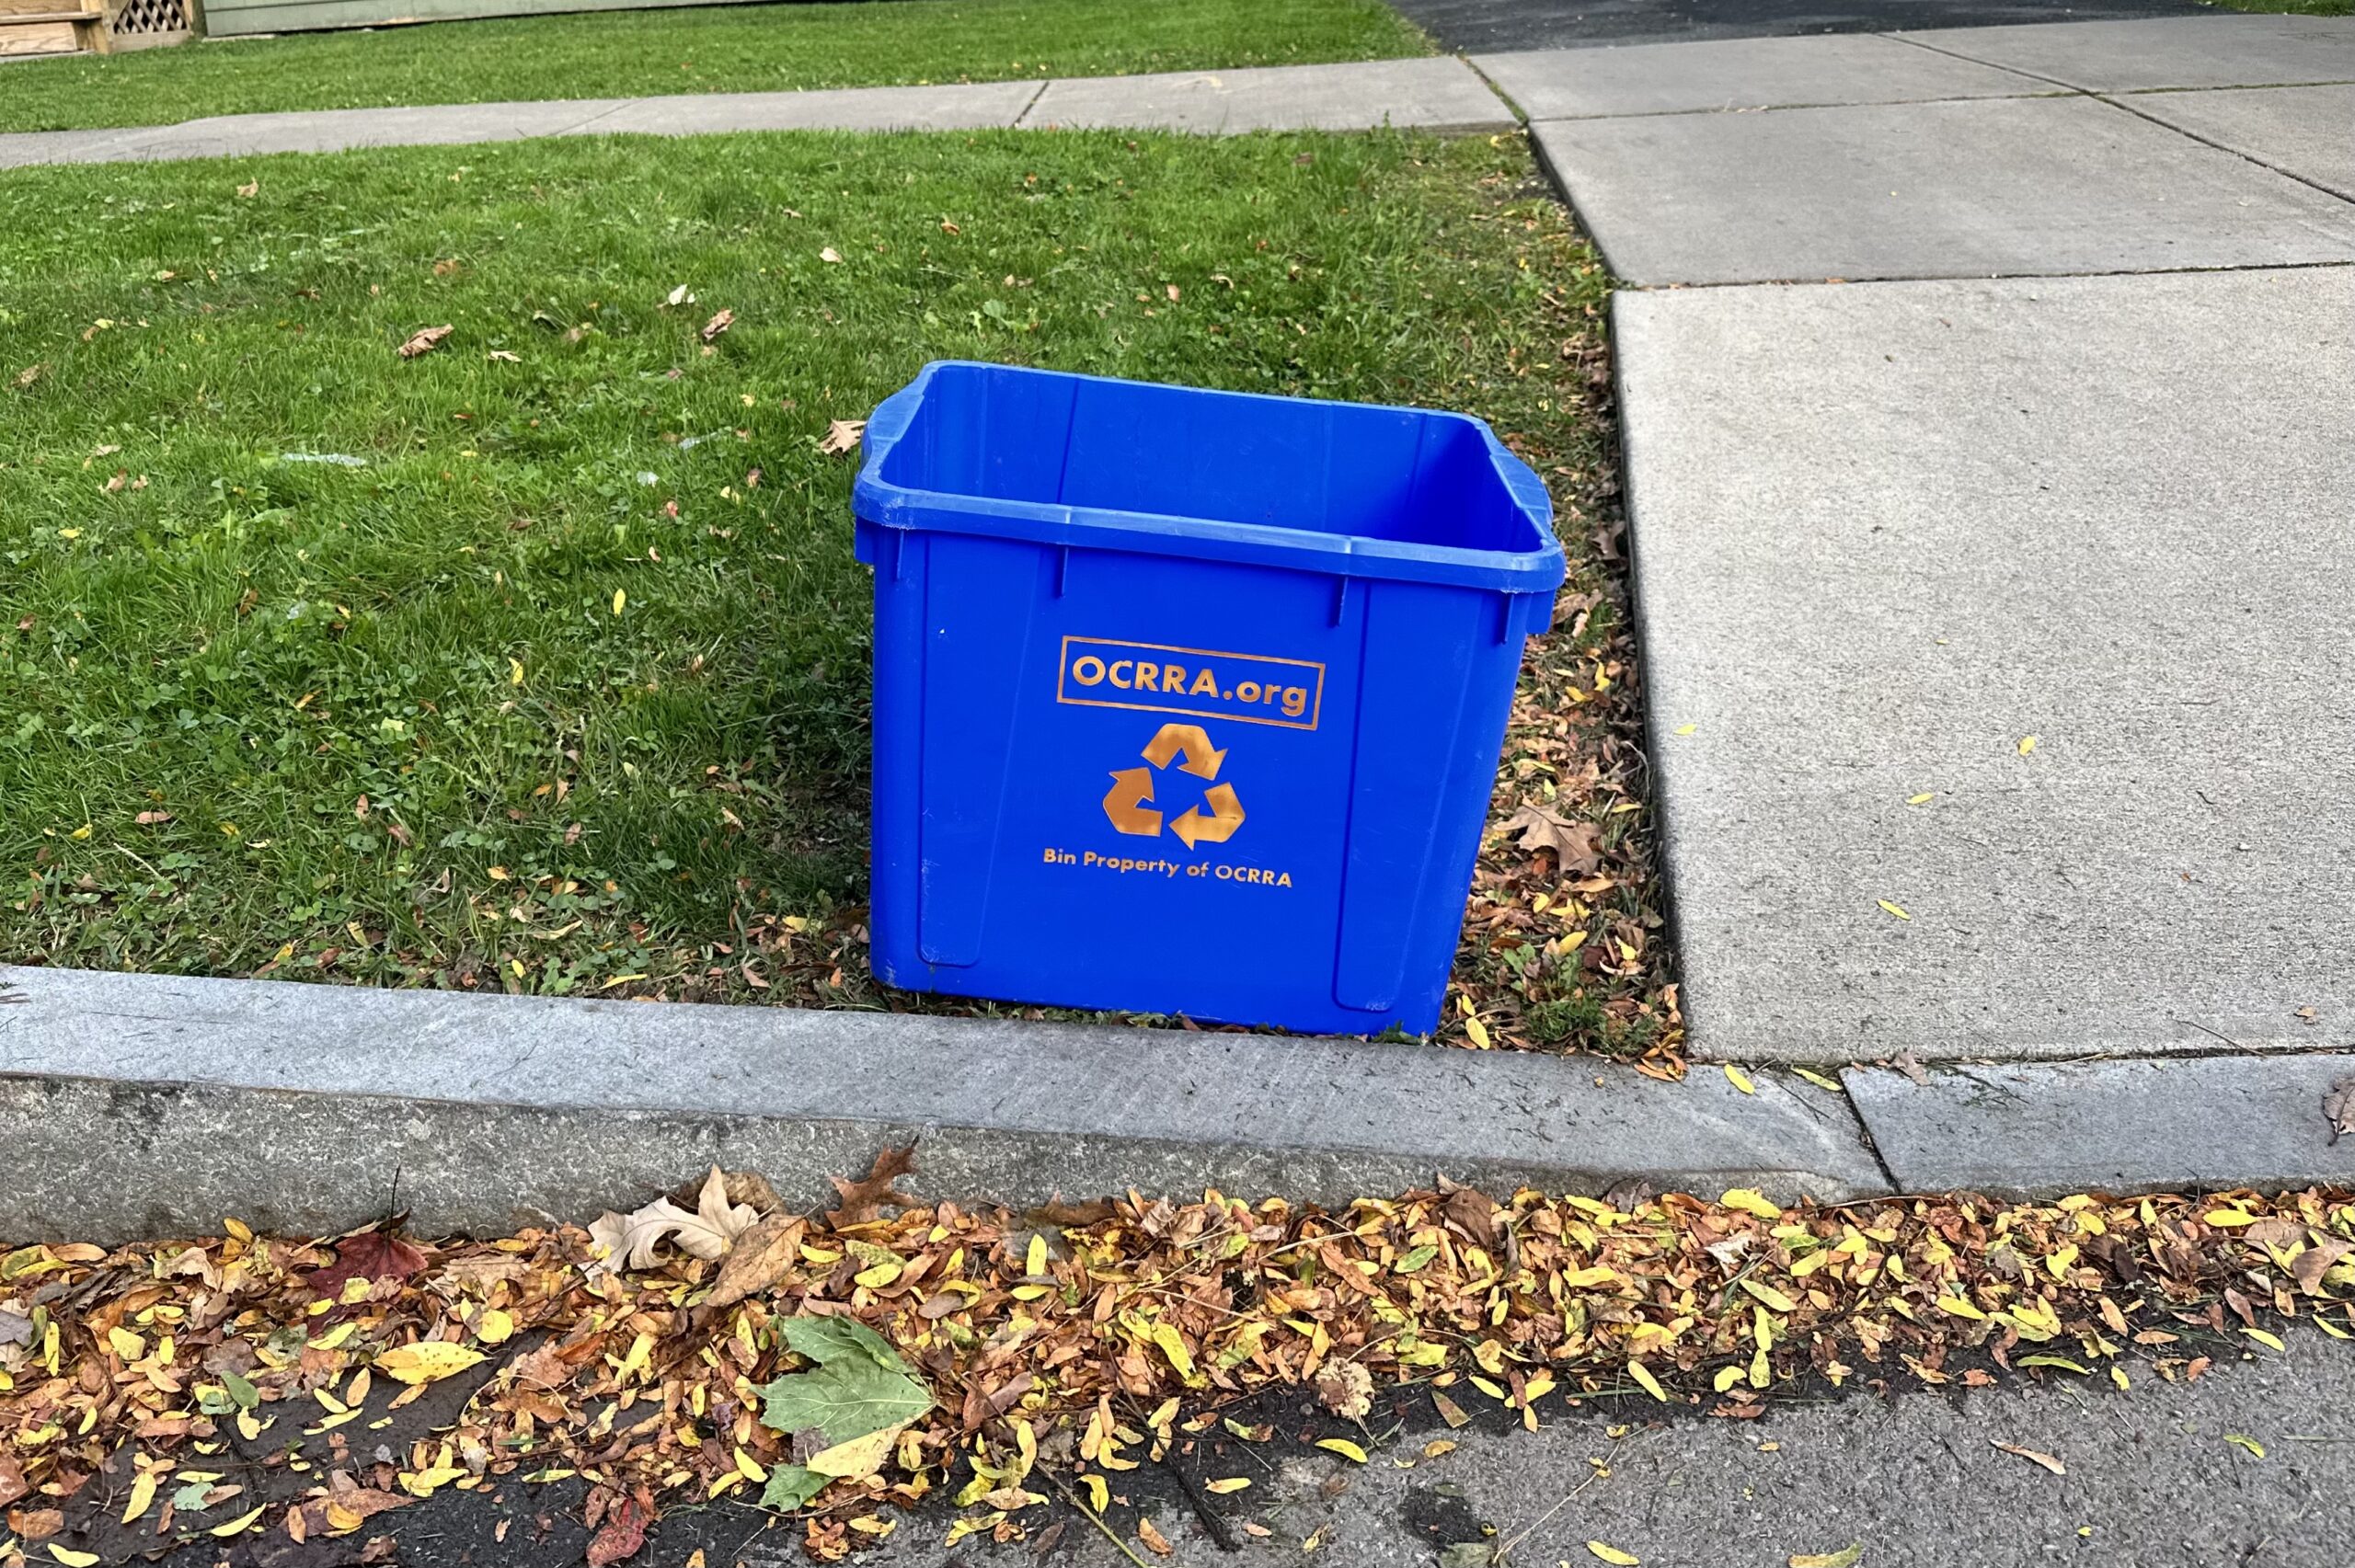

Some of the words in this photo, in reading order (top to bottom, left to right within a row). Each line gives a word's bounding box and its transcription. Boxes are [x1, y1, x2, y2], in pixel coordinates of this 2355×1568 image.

[1073, 656, 1307, 717] OCRRA.org
[1043, 848, 1076, 864] Bin
[1083, 851, 1180, 877] Property
[1187, 861, 1210, 877] of
[1215, 864, 1292, 887] OCRRA
